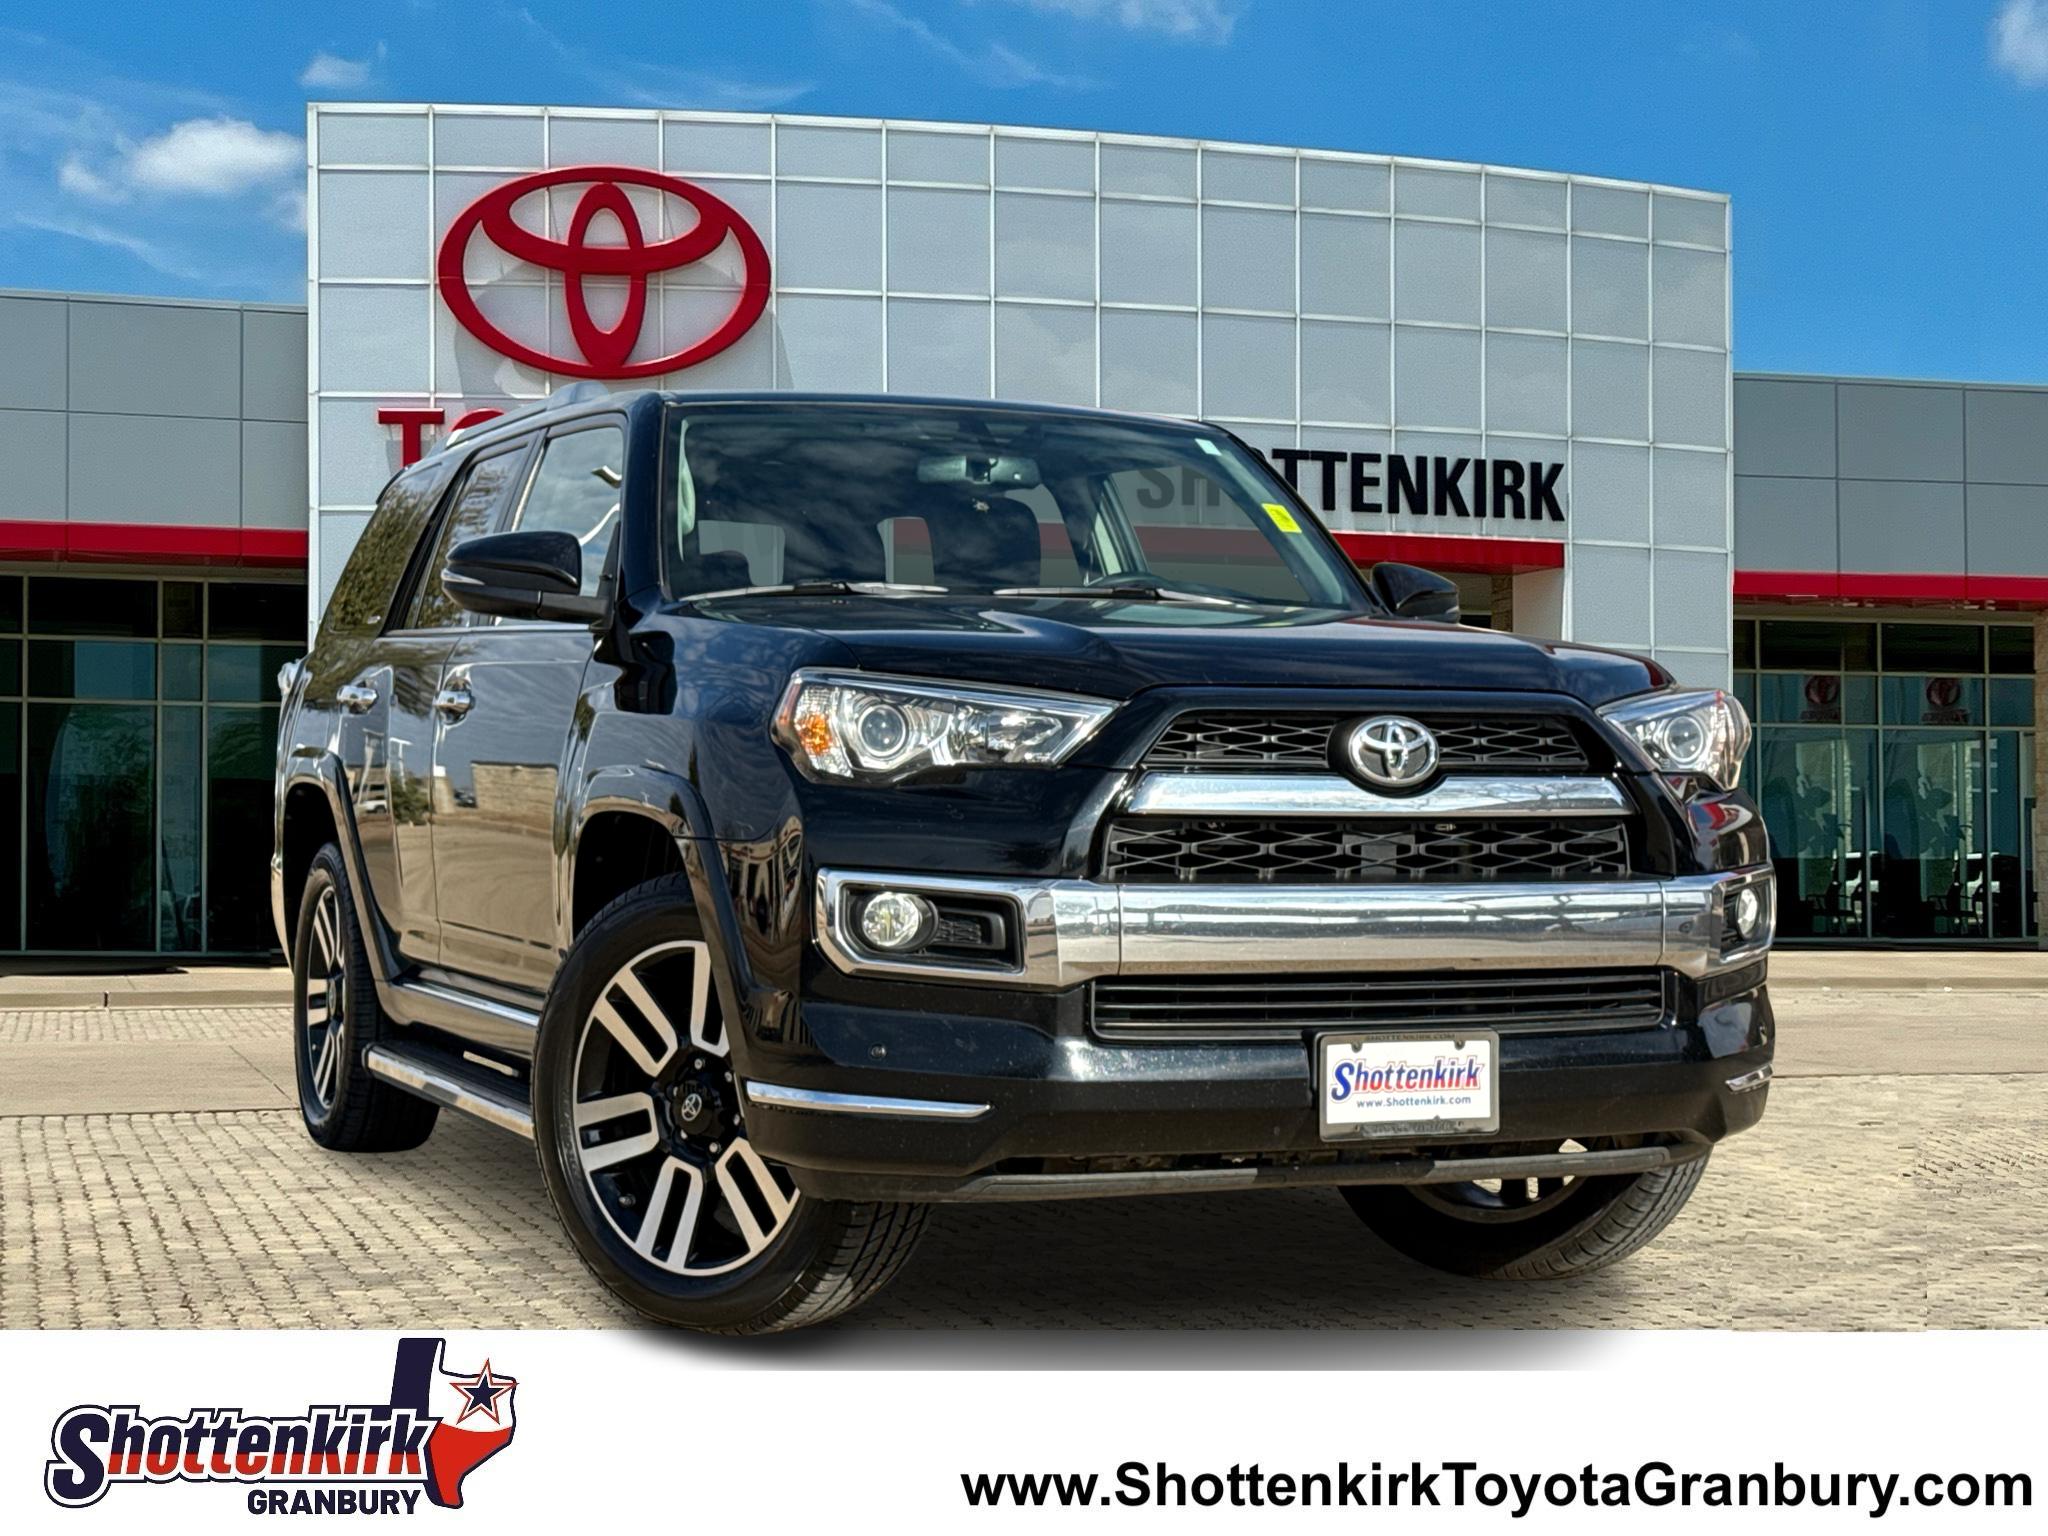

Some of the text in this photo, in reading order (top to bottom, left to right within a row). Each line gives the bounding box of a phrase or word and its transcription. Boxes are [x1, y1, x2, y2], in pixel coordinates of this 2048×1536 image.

[1136, 448, 1566, 522] SHTTENKIRK
[1330, 1057, 1482, 1102] Shottenkirk
[1356, 1095, 1472, 1109] www.Shottenkirk.com
